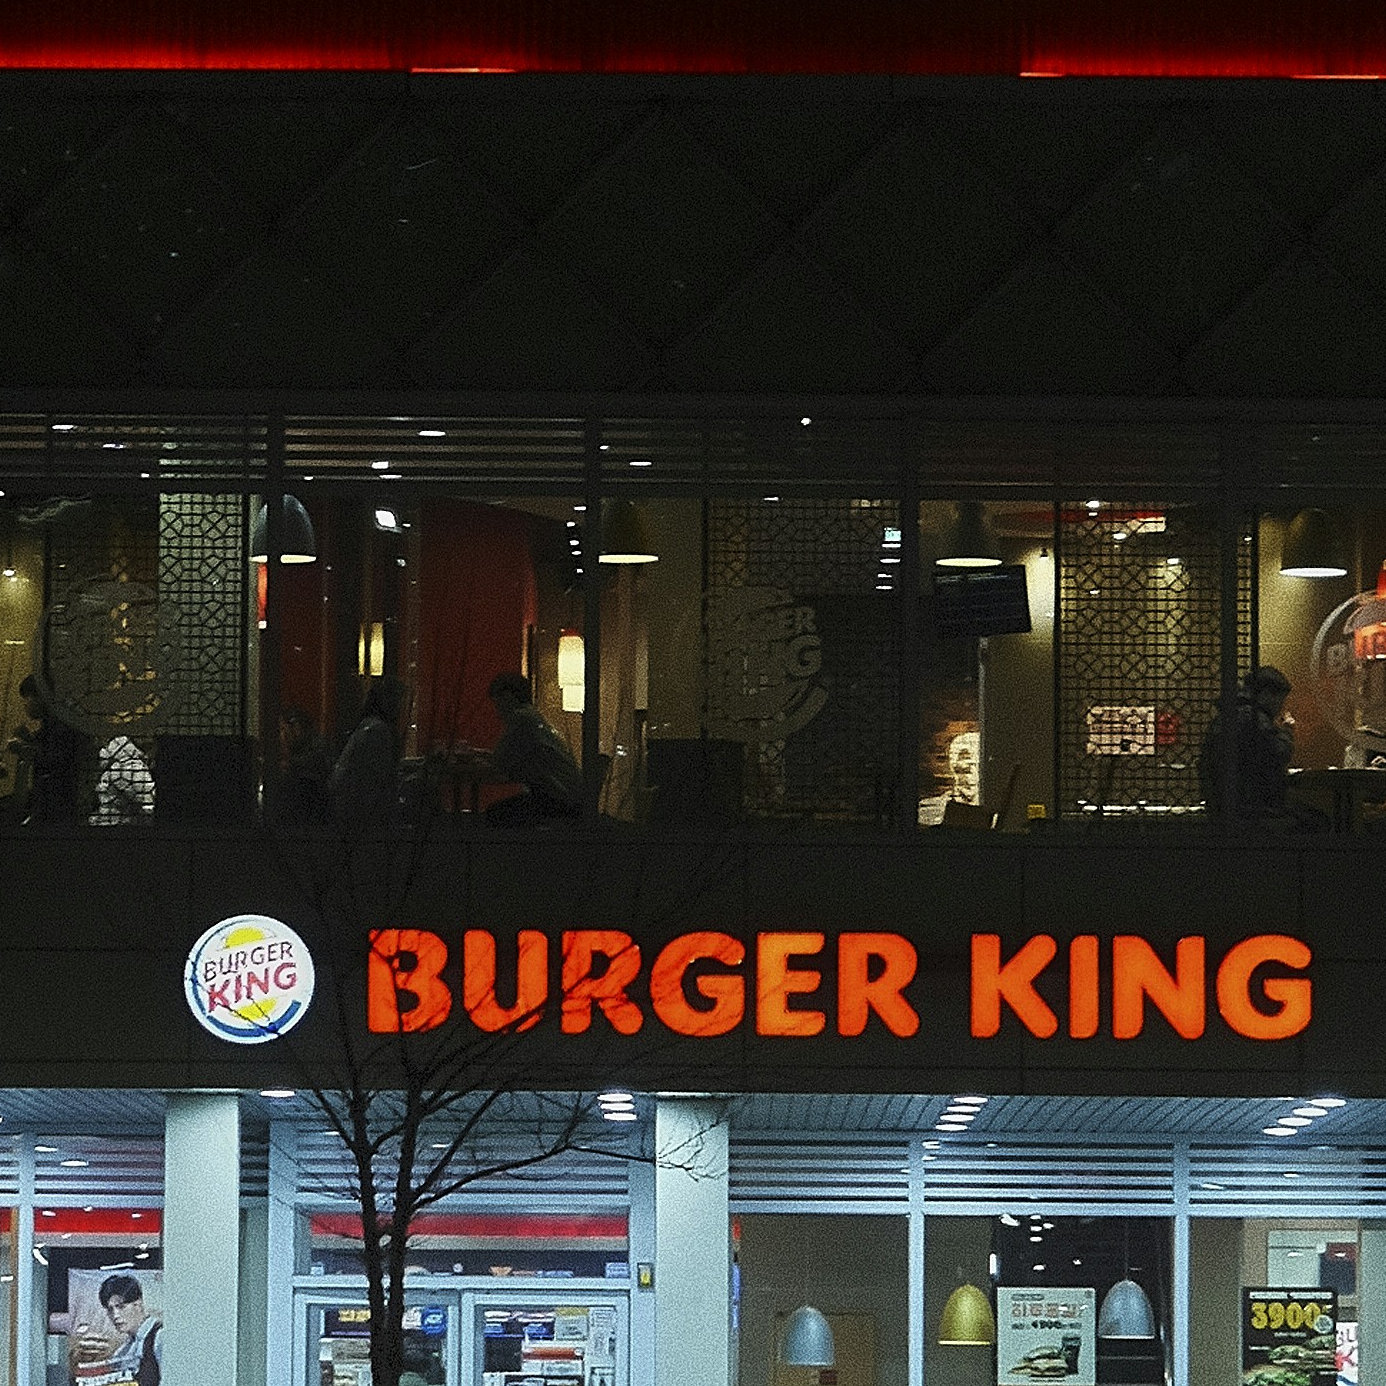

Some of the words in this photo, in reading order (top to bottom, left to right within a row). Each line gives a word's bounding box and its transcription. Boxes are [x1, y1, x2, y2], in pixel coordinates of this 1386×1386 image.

[203, 941, 294, 982] BURGER
[368, 929, 920, 1037] BURGER
[971, 933, 1313, 1041] KING
[207, 962, 297, 1013] KING
